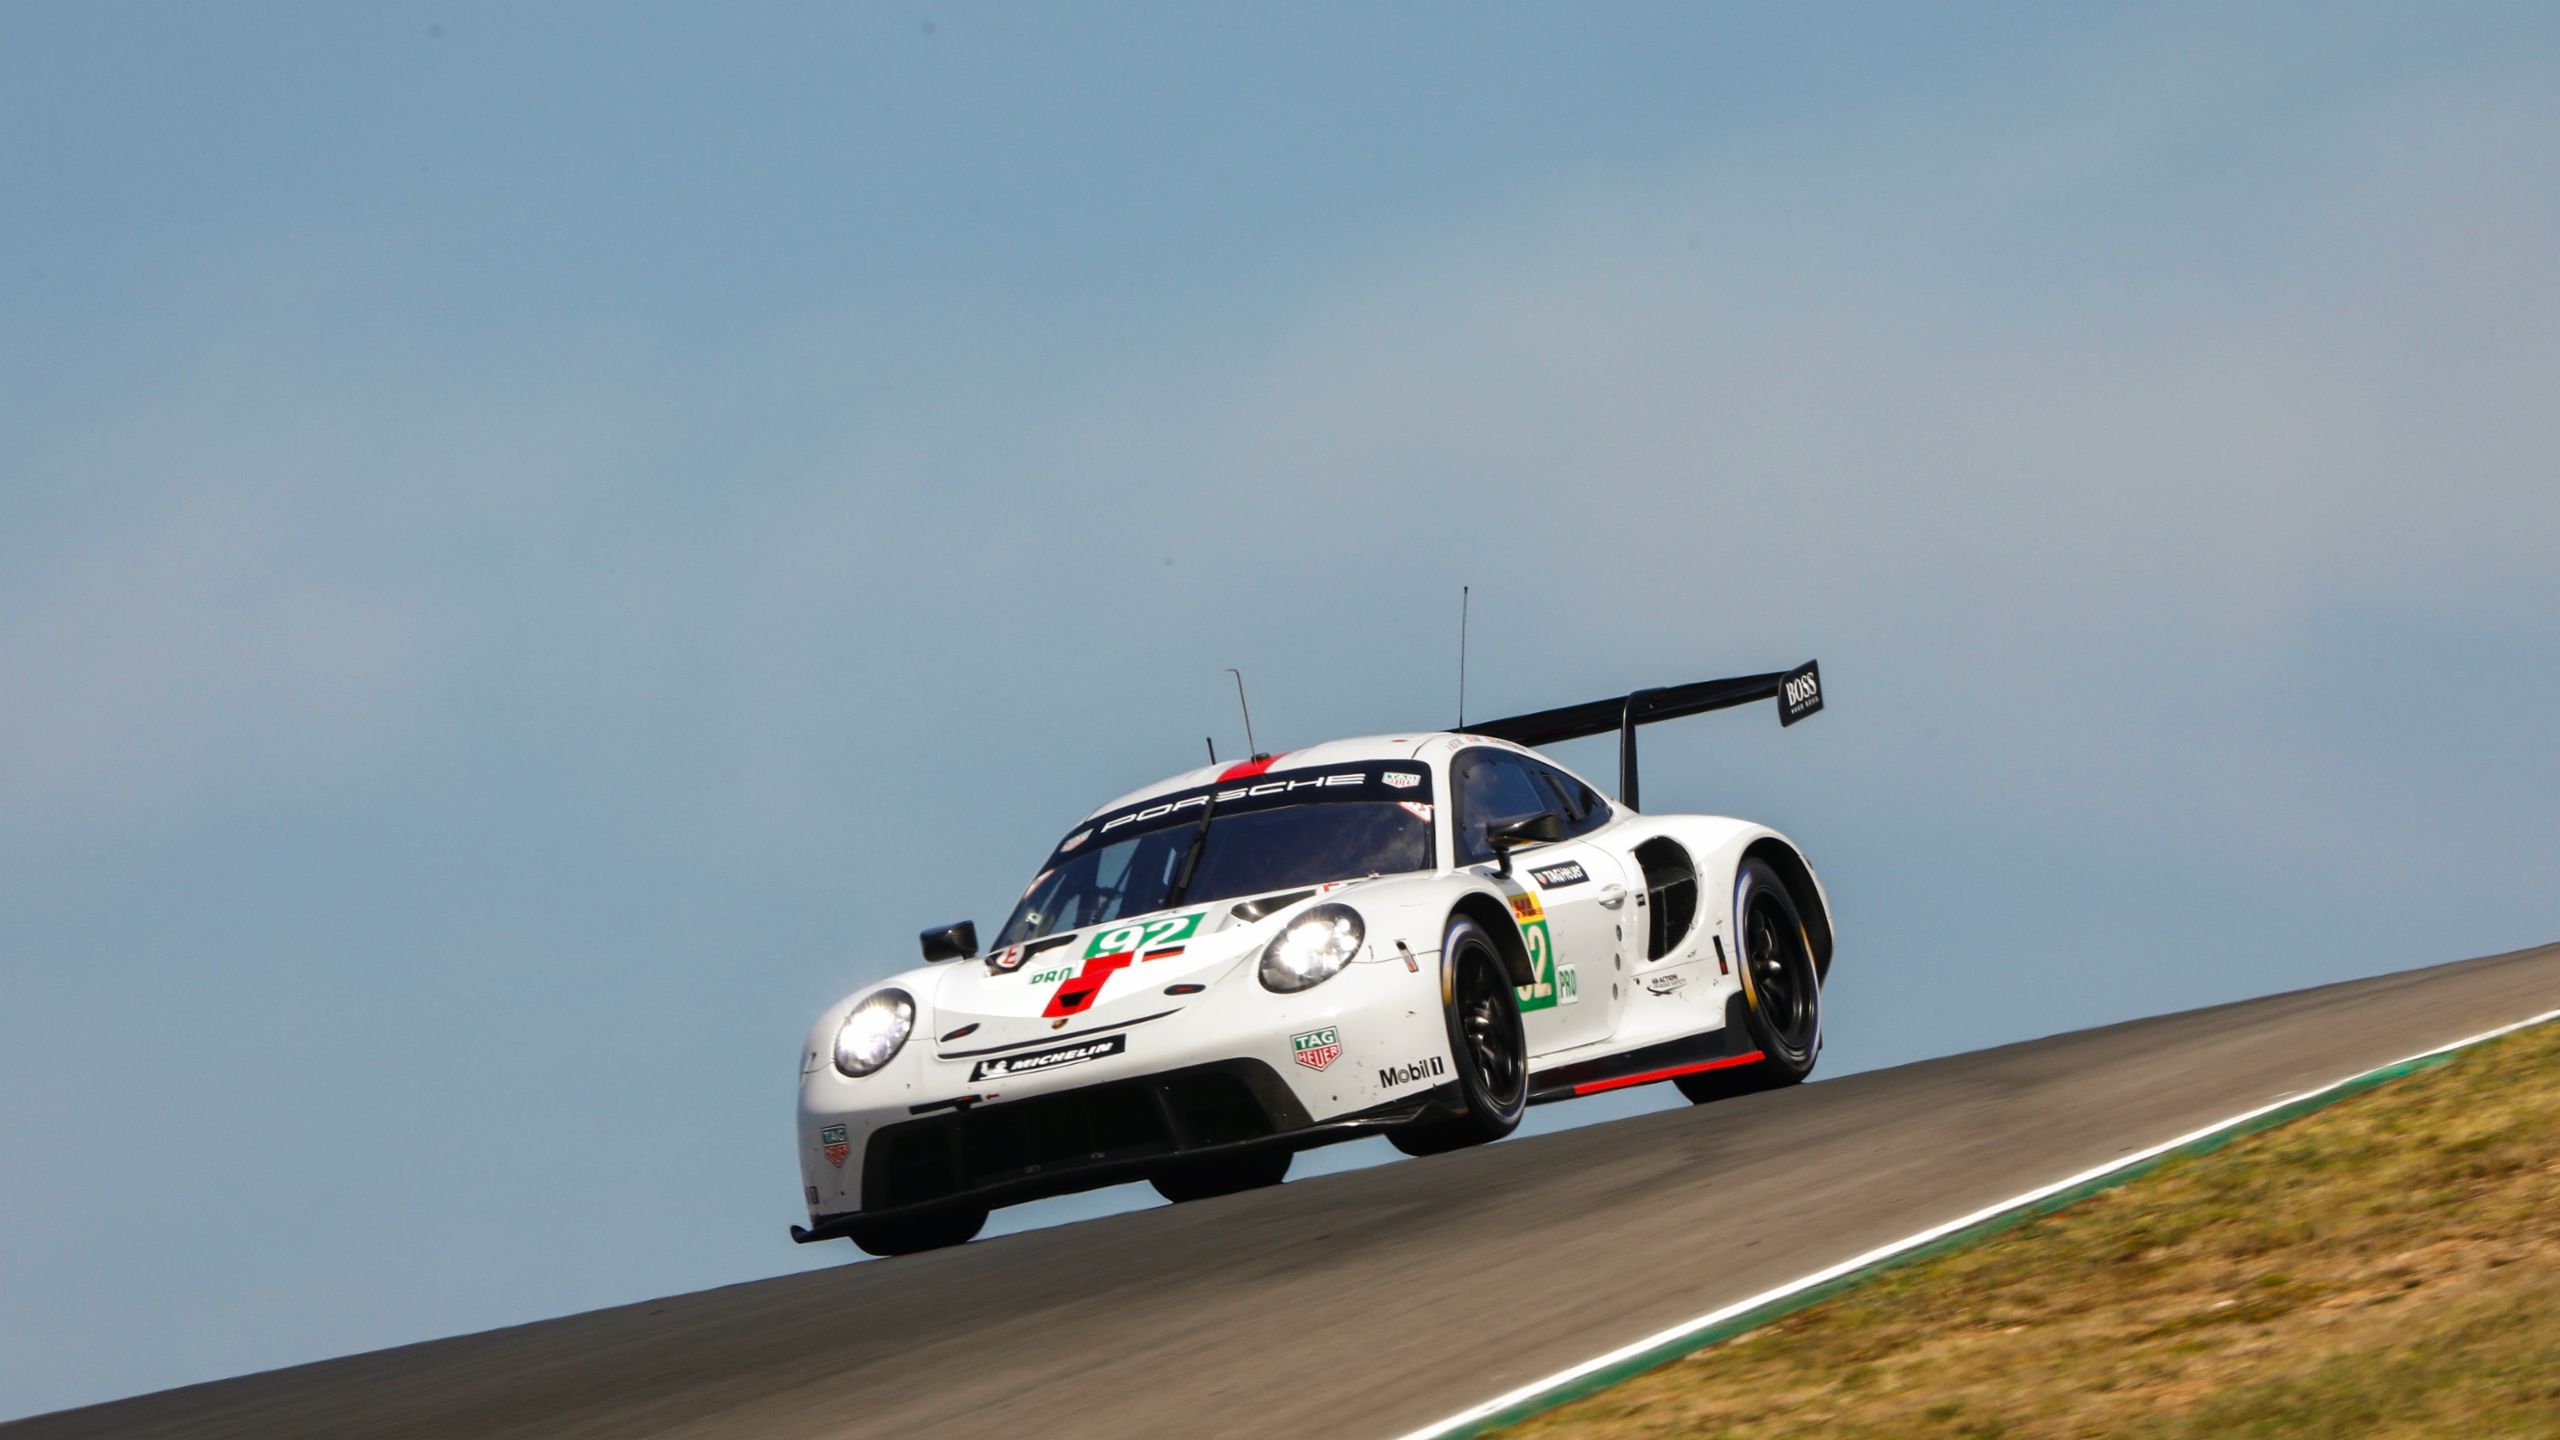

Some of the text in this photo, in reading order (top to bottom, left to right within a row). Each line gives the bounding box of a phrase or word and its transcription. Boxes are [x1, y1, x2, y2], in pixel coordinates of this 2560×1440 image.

[1785, 672, 1817, 706] BOSS
[1101, 773, 1366, 833] PORSCHE
[1095, 917, 1190, 958] 92
[1517, 925, 1552, 1001] 2
[1559, 969, 1577, 998] PRO
[1296, 1031, 1335, 1048] TAG
[1011, 1042, 1113, 1070] MICHELIN
[1298, 1046, 1338, 1067] HEUER
[1379, 1057, 1443, 1088] Mobil 1
